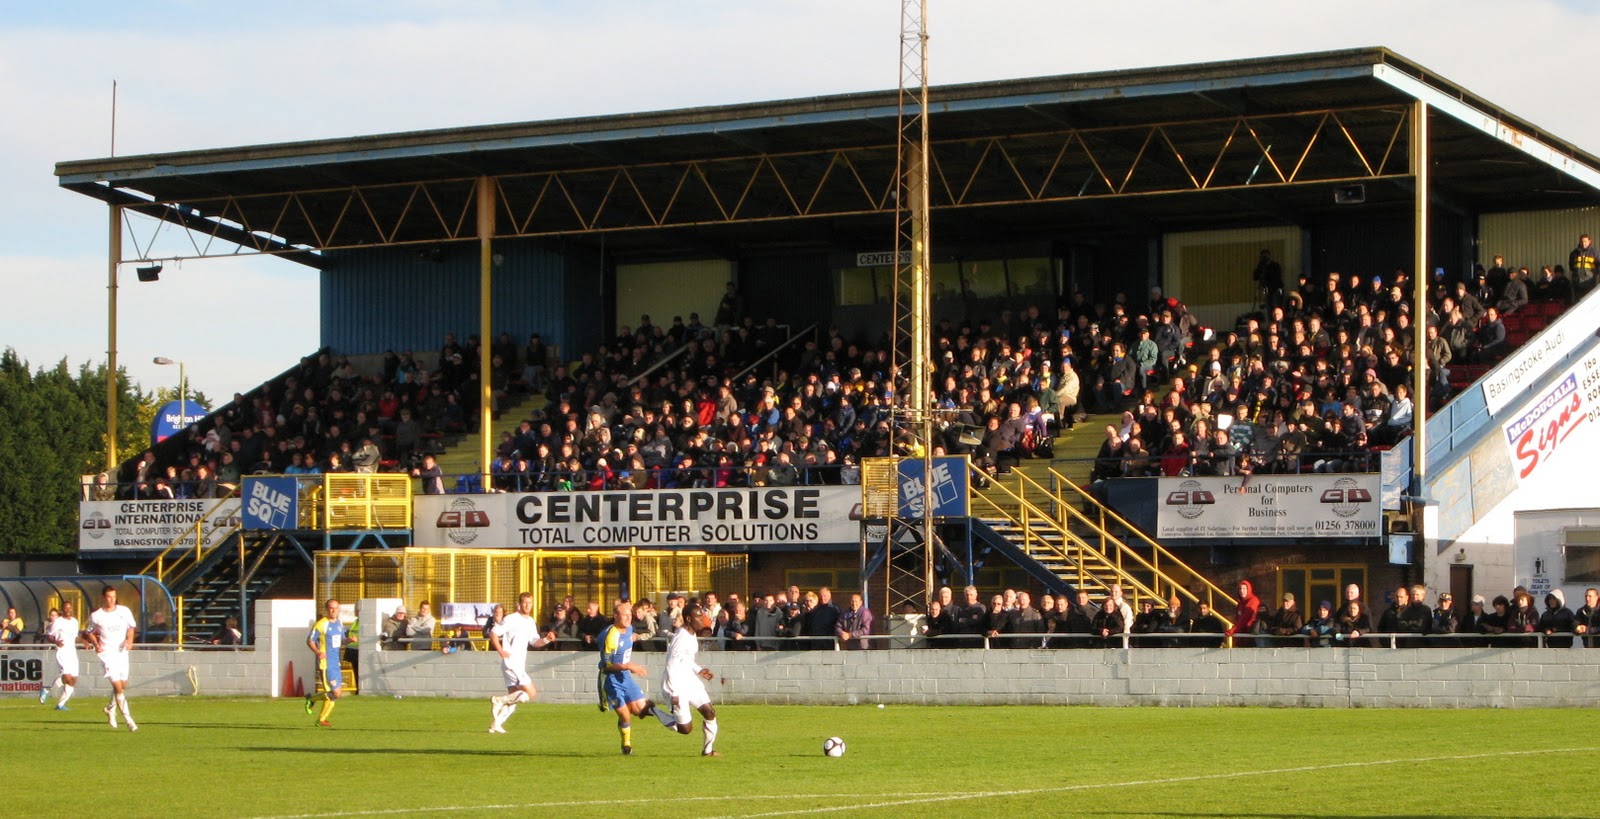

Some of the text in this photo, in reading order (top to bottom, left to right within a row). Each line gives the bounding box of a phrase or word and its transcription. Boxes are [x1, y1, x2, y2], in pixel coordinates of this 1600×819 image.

[860, 252, 912, 265] CENTERPR
[1488, 328, 1566, 399] Basingstoke Audi
[1508, 378, 1576, 441] McDOUGALL
[1516, 391, 1582, 479] Signs
[1223, 483, 1313, 495] Peronal Computers
[252, 480, 292, 514] BLUE
[1261, 495, 1274, 505] for
[120, 501, 204, 513] CENTERPRISE
[247, 497, 272, 524] SQ
[515, 489, 820, 525] CENTERPRISE
[1248, 507, 1287, 517] Business
[114, 513, 209, 525] INTERNATIONAL
[1315, 520, 1376, 530] 01256 378000
[115, 527, 134, 536] TOTAL
[135, 527, 171, 536] COMPUTER
[518, 522, 819, 544] TOTAL COMPUTER SOLUTIONS
[113, 538, 174, 546] BASINGSTOKE
[1, 654, 43, 681] ise
